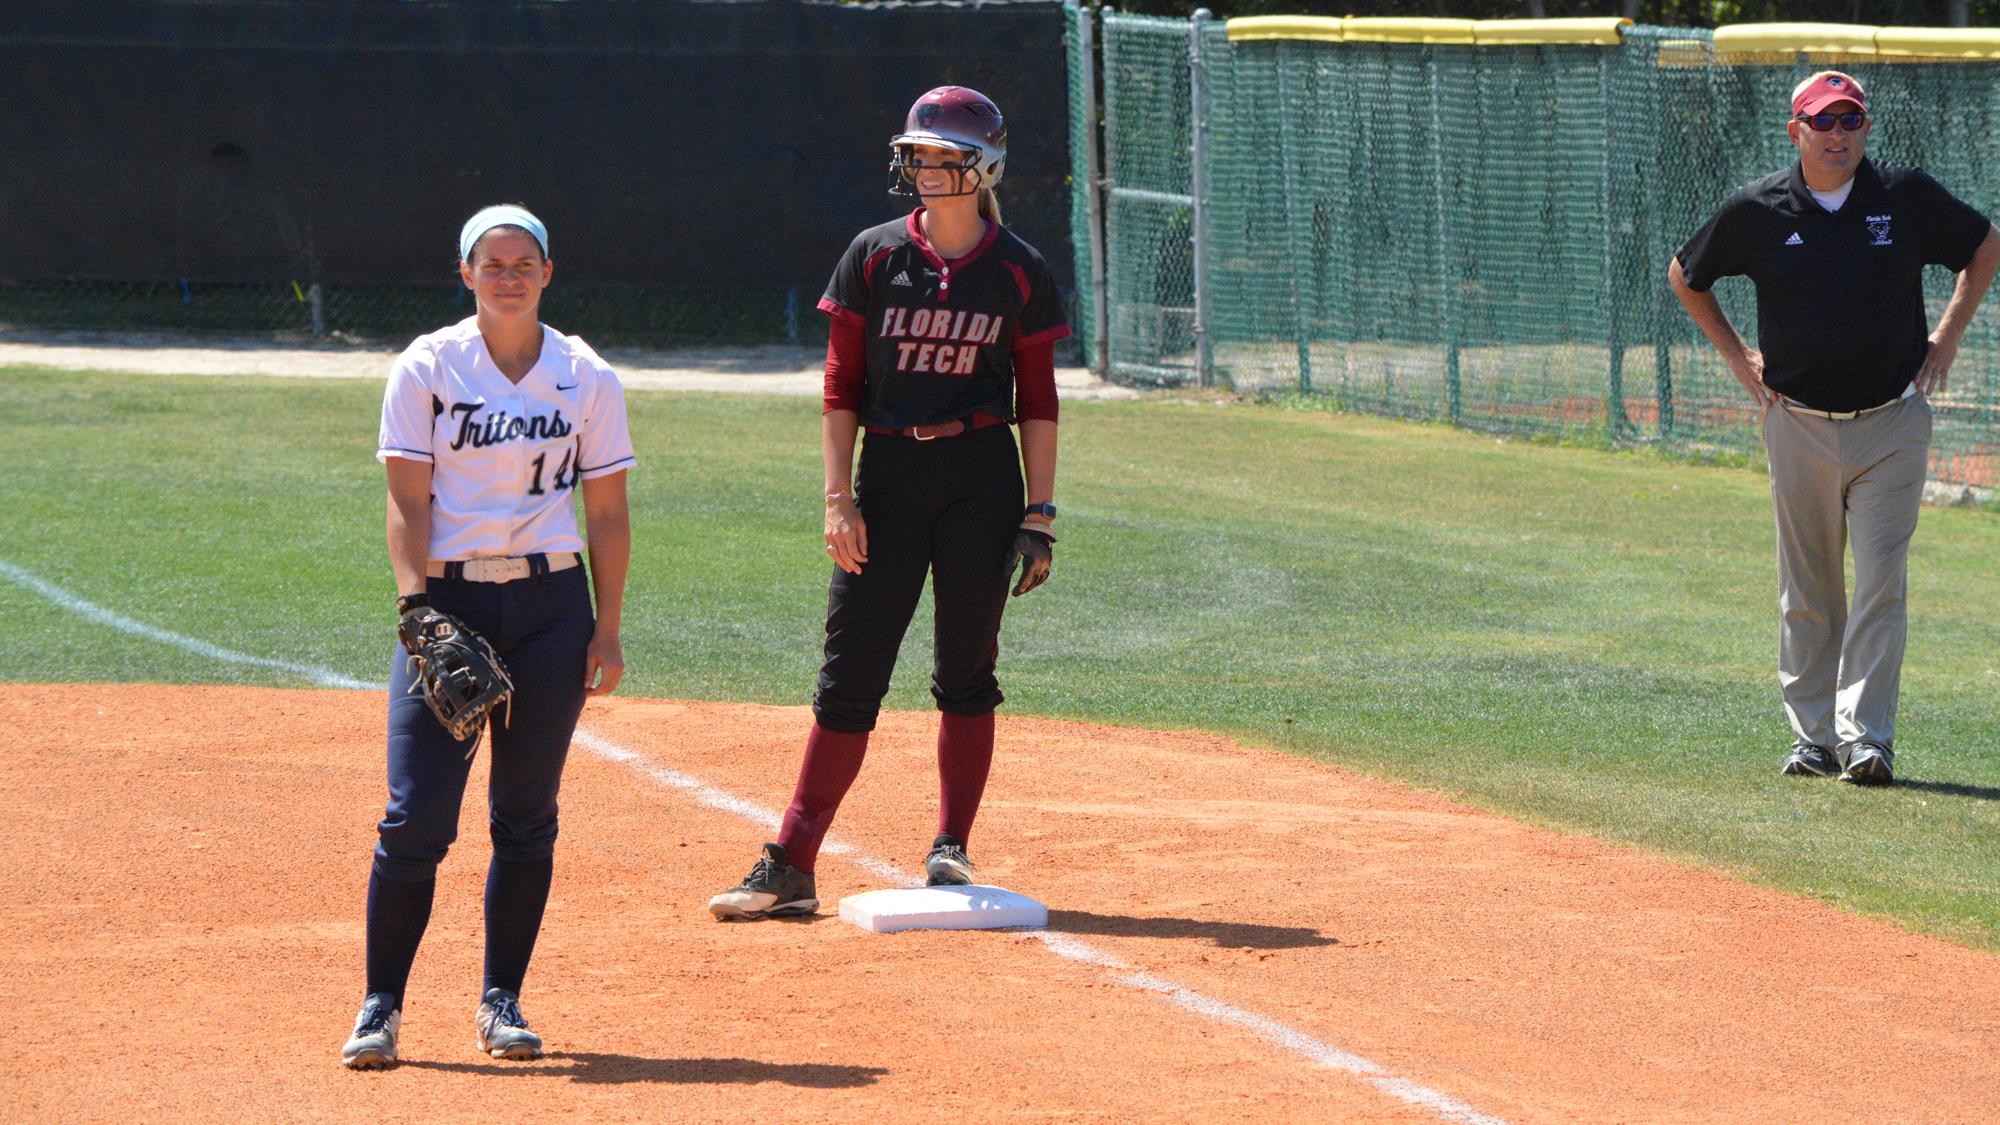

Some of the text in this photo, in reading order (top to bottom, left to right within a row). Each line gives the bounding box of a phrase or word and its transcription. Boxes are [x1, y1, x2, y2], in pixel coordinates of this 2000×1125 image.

[879, 306, 1004, 345] FLORIDA
[896, 341, 979, 375] TECH
[450, 402, 572, 451] Tritons
